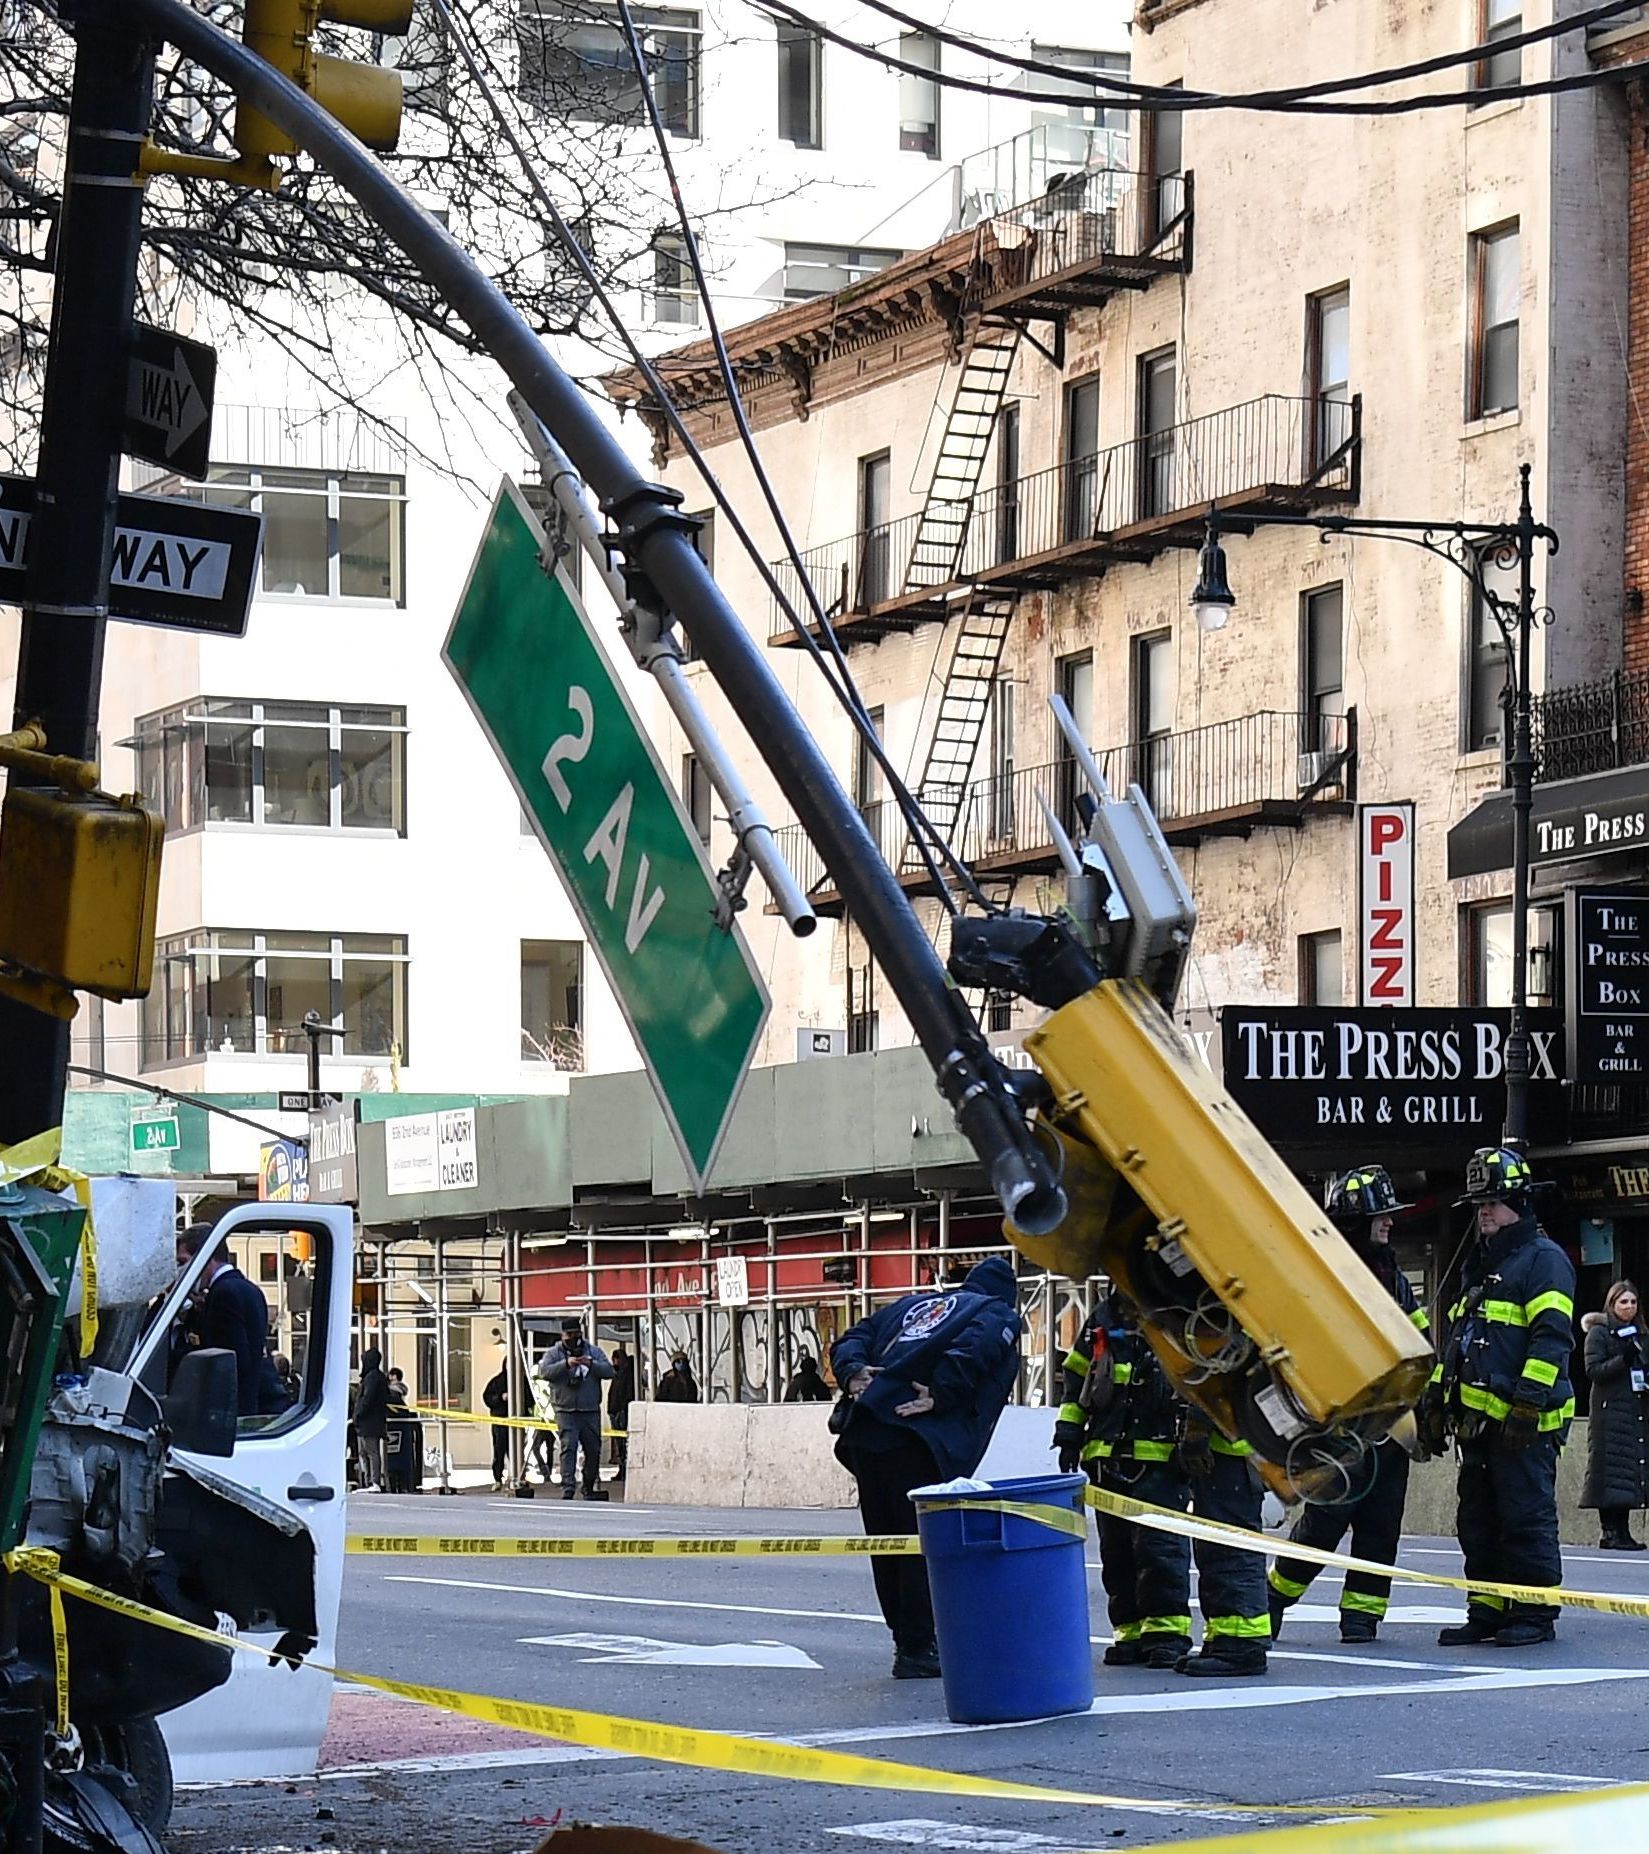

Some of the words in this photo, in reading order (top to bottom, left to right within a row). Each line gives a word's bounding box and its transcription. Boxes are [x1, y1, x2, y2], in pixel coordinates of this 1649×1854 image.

[141, 369, 192, 428] WAY
[542, 686, 594, 815] 2
[583, 781, 665, 954] AV
[1537, 822, 1575, 853] THE
[1584, 812, 1645, 845] PRESS
[1370, 815, 1404, 1007] PIZZ
[1597, 908, 1638, 931] THE
[1598, 981, 1641, 1004] BOX
[1605, 1024, 1634, 1037] BAR
[1238, 1022, 1326, 1080] THE
[1334, 1022, 1462, 1080] PRESS
[1614, 1041, 1626, 1055] &
[1598, 1058, 1642, 1072] GRILL
[1317, 1096, 1365, 1124] BAR
[1376, 1097, 1393, 1124] &
[1404, 1096, 1483, 1124] GRILL
[440, 1120, 473, 1145] LAUNDRY
[442, 1161, 475, 1185] CLEANER
[1469, 1169, 1485, 1184] 21
